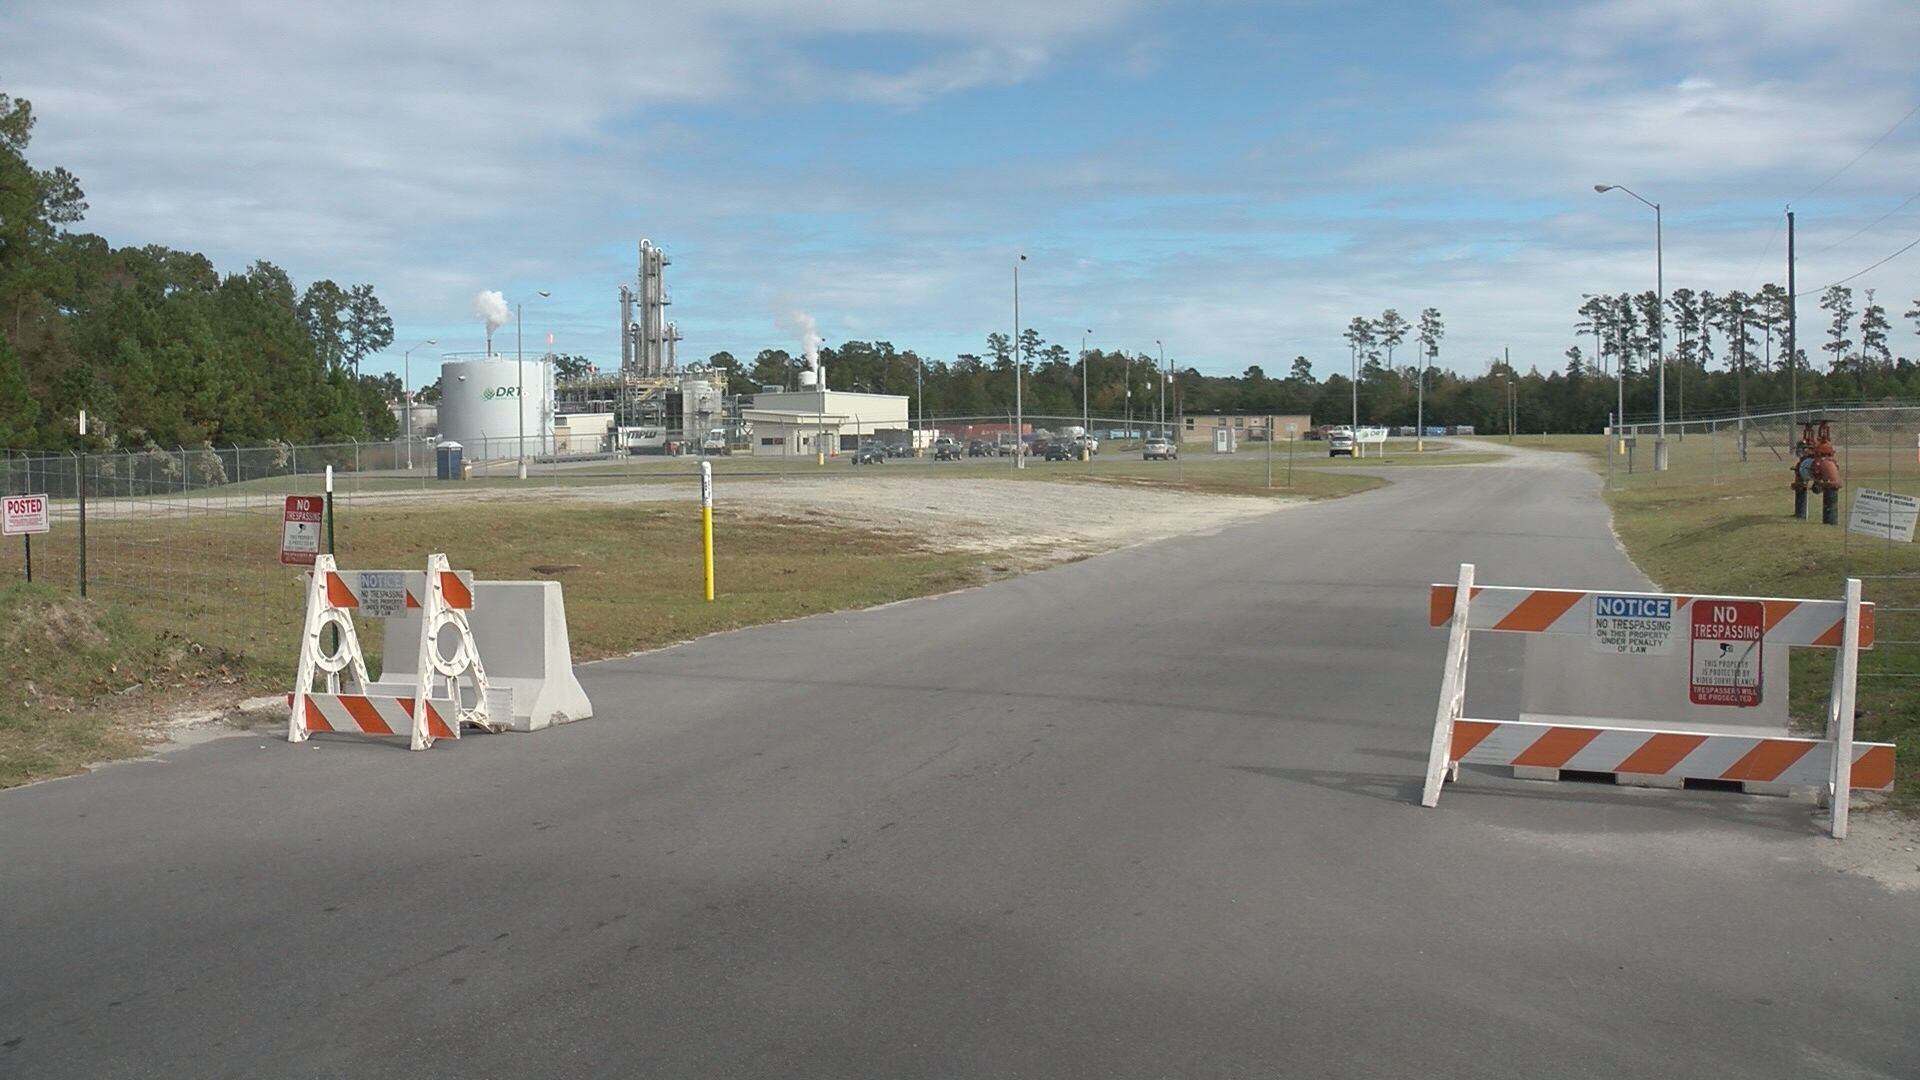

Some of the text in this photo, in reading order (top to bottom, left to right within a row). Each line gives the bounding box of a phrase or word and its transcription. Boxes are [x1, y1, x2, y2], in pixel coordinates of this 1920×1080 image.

[8, 499, 42, 513] POSTED
[297, 499, 310, 511] NO
[286, 511, 321, 520] TRESPASSING
[362, 574, 404, 588] NOTICE
[361, 590, 403, 599] NO TRESPASSING
[1598, 599, 1669, 617] NOTICE
[1713, 606, 1738, 623] NO
[1596, 619, 1671, 631] NO TRESPASSING
[1629, 631, 1668, 639] PROPERTY
[1694, 624, 1760, 639] TRESPASSING
[1629, 638, 1663, 647] PENALTY
[1696, 676, 1756, 685] VIDEO SURVEILANCE
[1693, 686, 1757, 696] TRESPASSERS WILL
